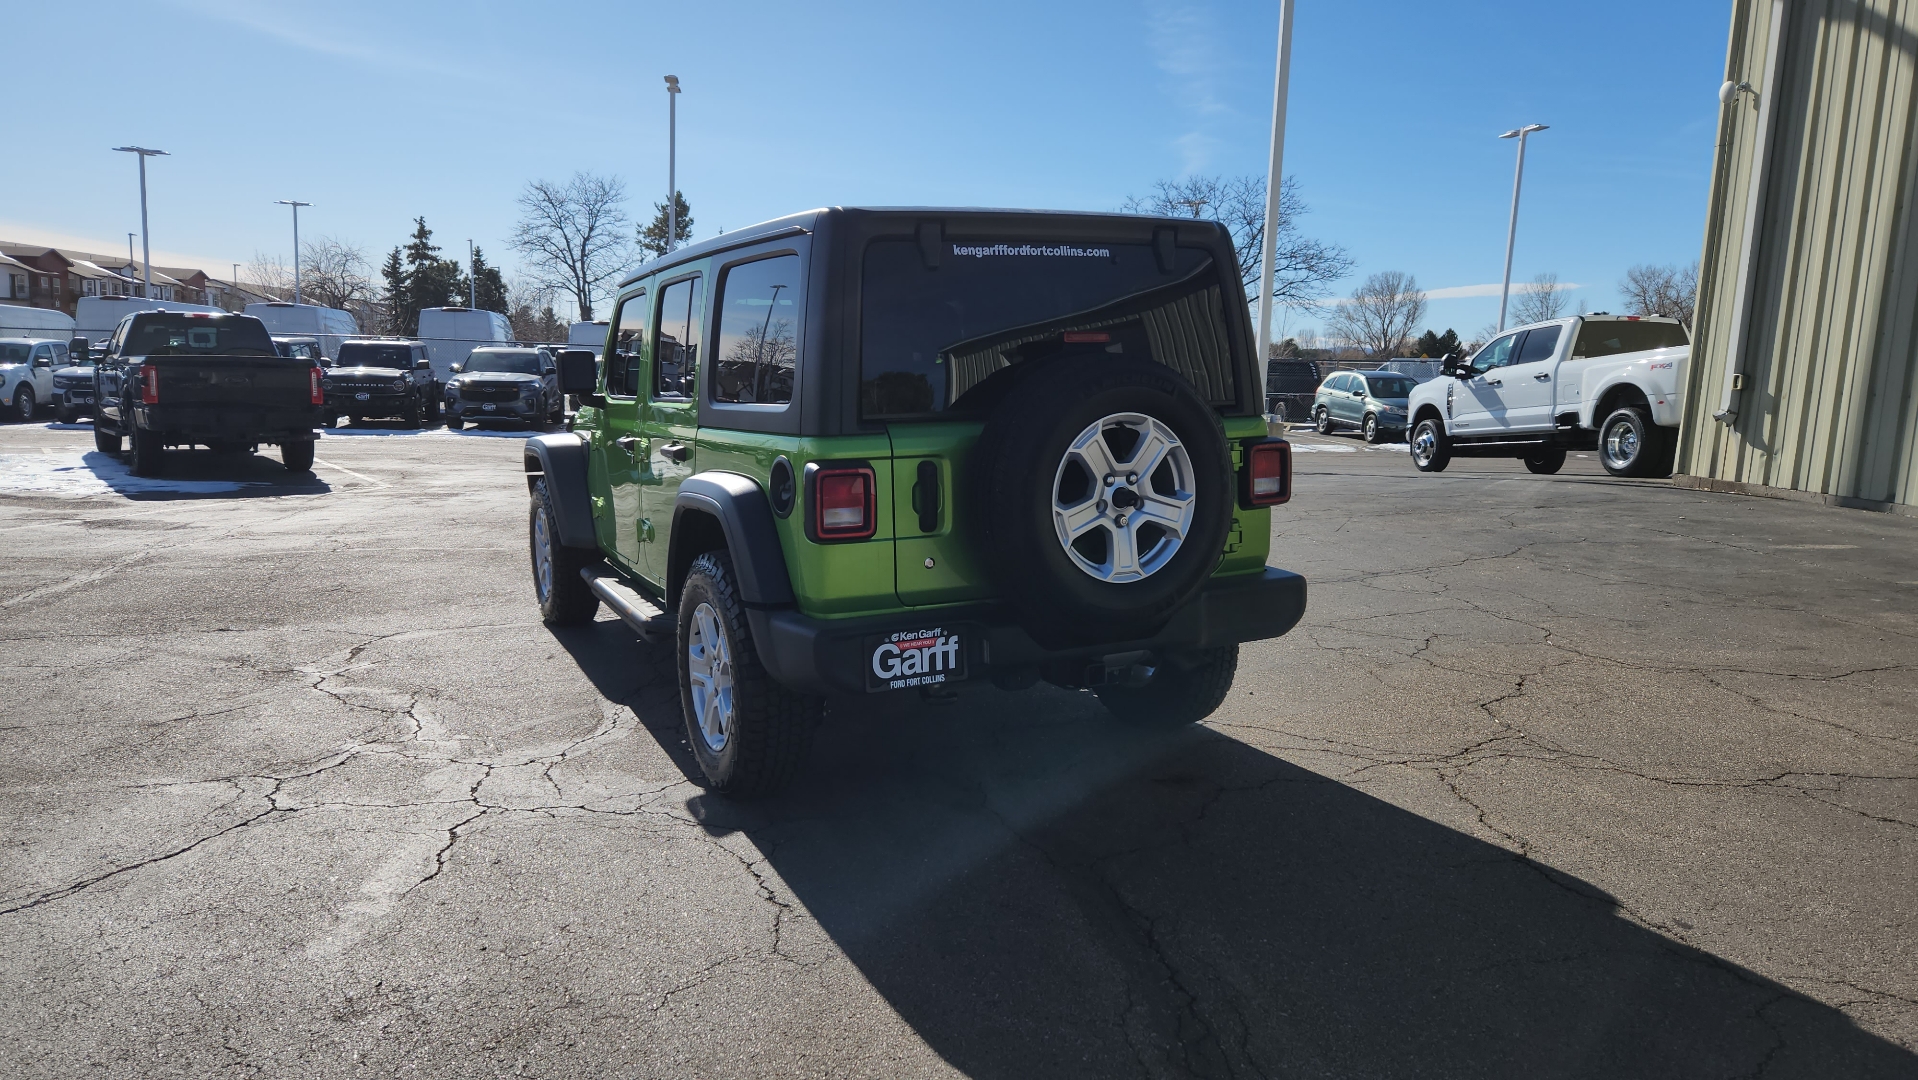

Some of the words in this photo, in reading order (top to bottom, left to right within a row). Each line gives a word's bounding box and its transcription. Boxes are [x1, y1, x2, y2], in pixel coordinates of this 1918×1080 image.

[953, 244, 1110, 258] kengarfffordfortcollins.com
[900, 631, 918, 641] Ken
[918, 627, 942, 639] Garff
[872, 635, 958, 679] Garff
[890, 680, 906, 690] FORD
[906, 677, 921, 687] FORT
[922, 674, 945, 685] COLLINS
